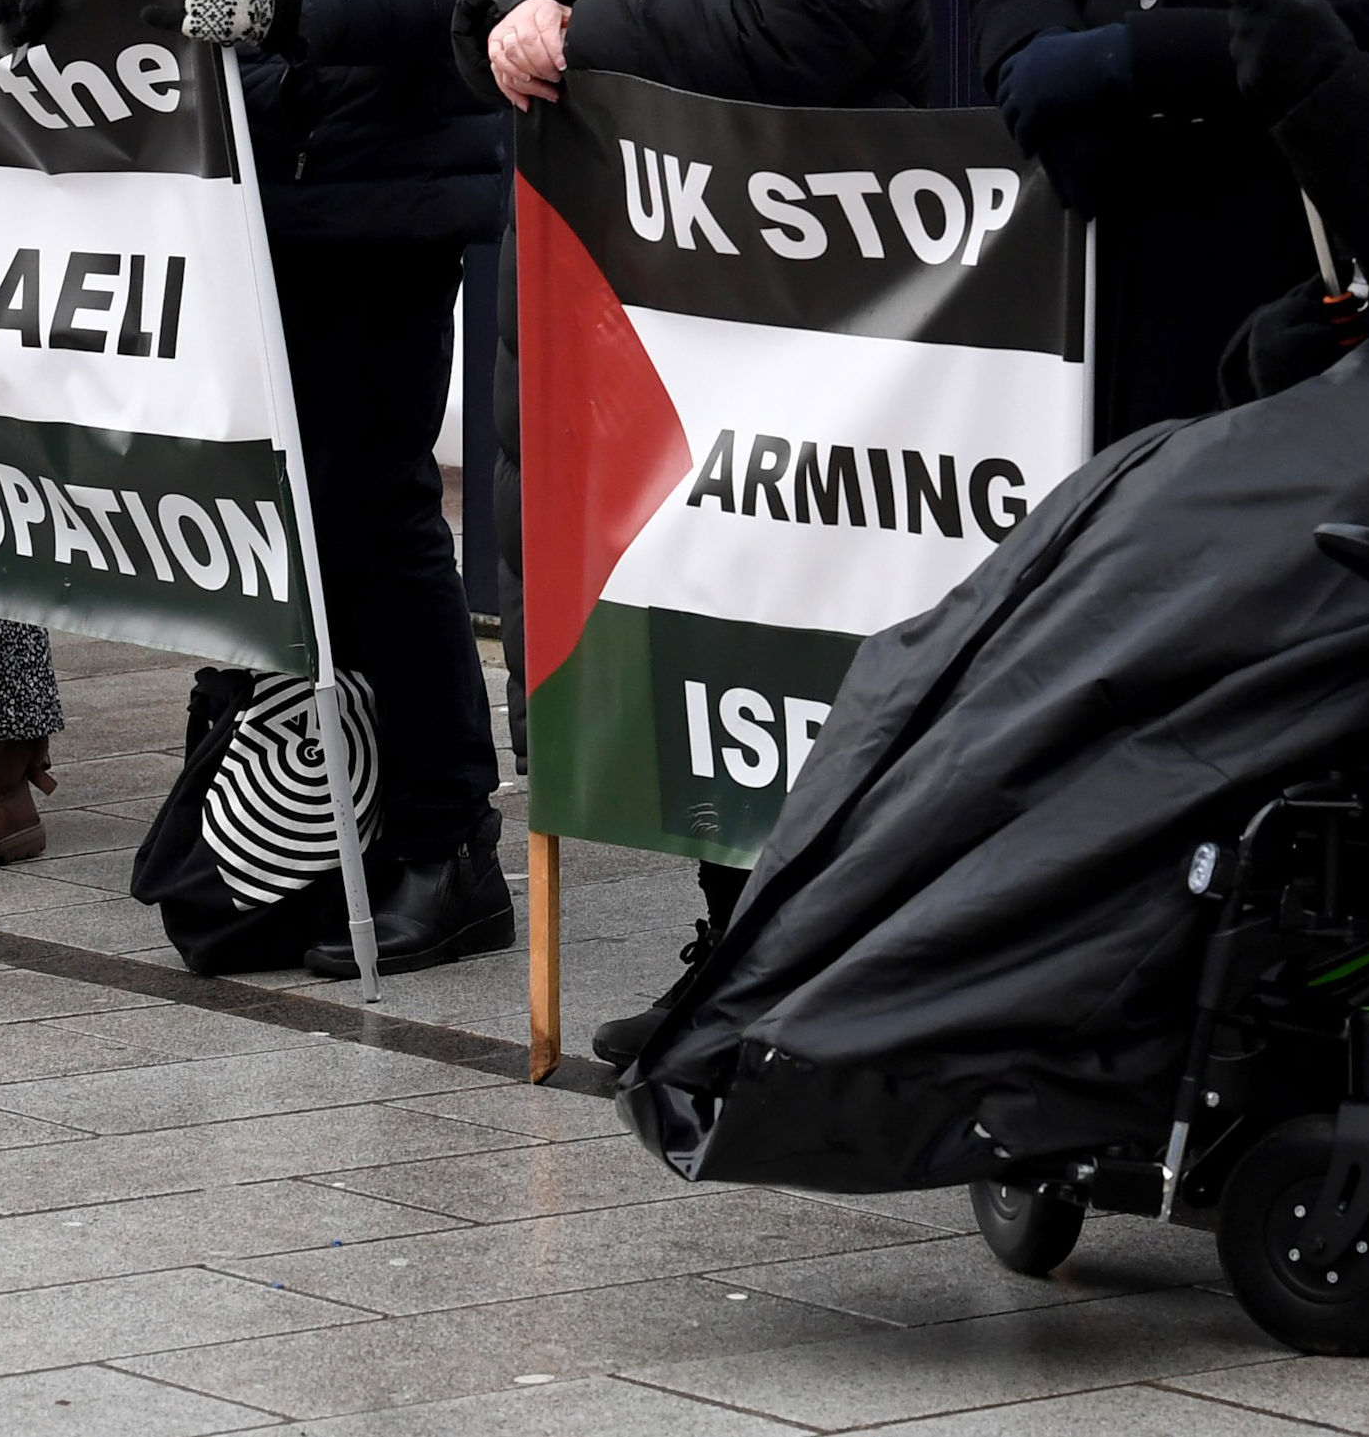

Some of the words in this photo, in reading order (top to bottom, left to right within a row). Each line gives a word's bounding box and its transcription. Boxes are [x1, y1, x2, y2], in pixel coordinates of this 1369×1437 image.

[618, 138, 741, 257] UK
[747, 167, 1021, 267] STOP
[686, 429, 1029, 546] ARMING
